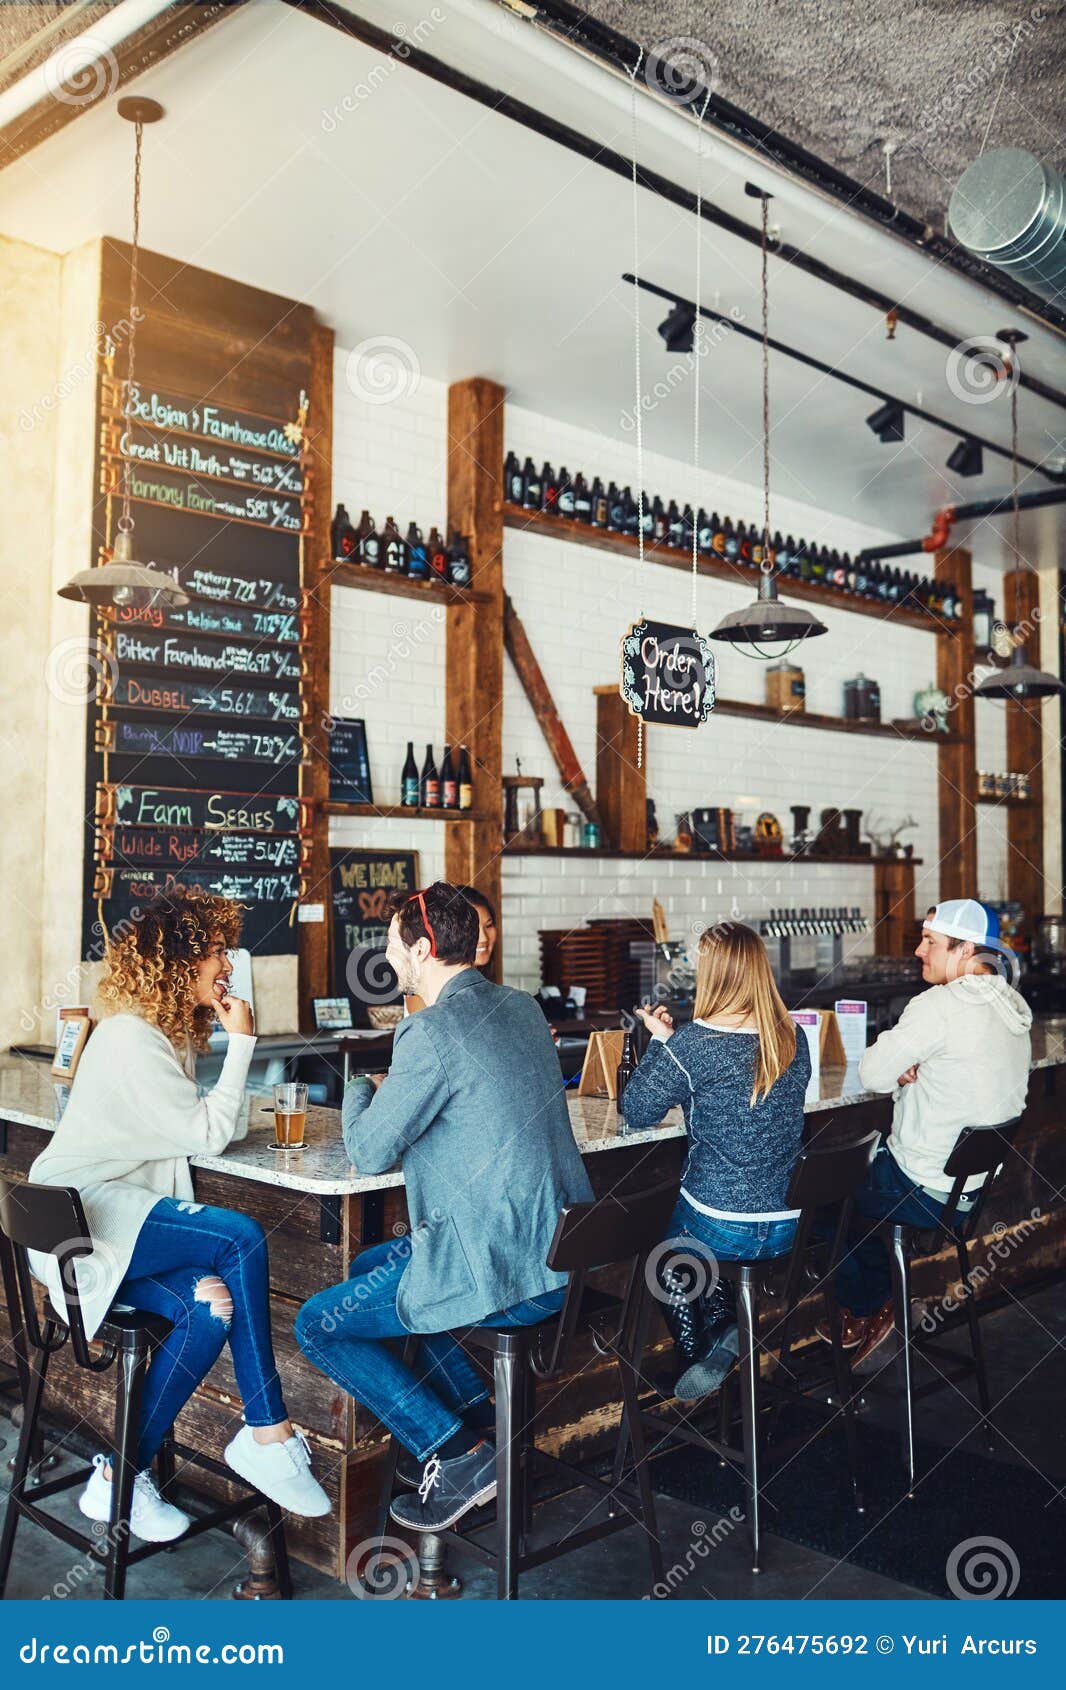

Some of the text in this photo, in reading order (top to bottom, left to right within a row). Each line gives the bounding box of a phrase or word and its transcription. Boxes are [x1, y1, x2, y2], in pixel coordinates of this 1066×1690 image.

[641, 636, 697, 674] Order
[128, 680, 191, 710] DUBBEL
[642, 674, 701, 719] Here!
[137, 791, 194, 826] Farm
[339, 862, 408, 890] WE HAVE
[345, 924, 392, 950] PRETZ
